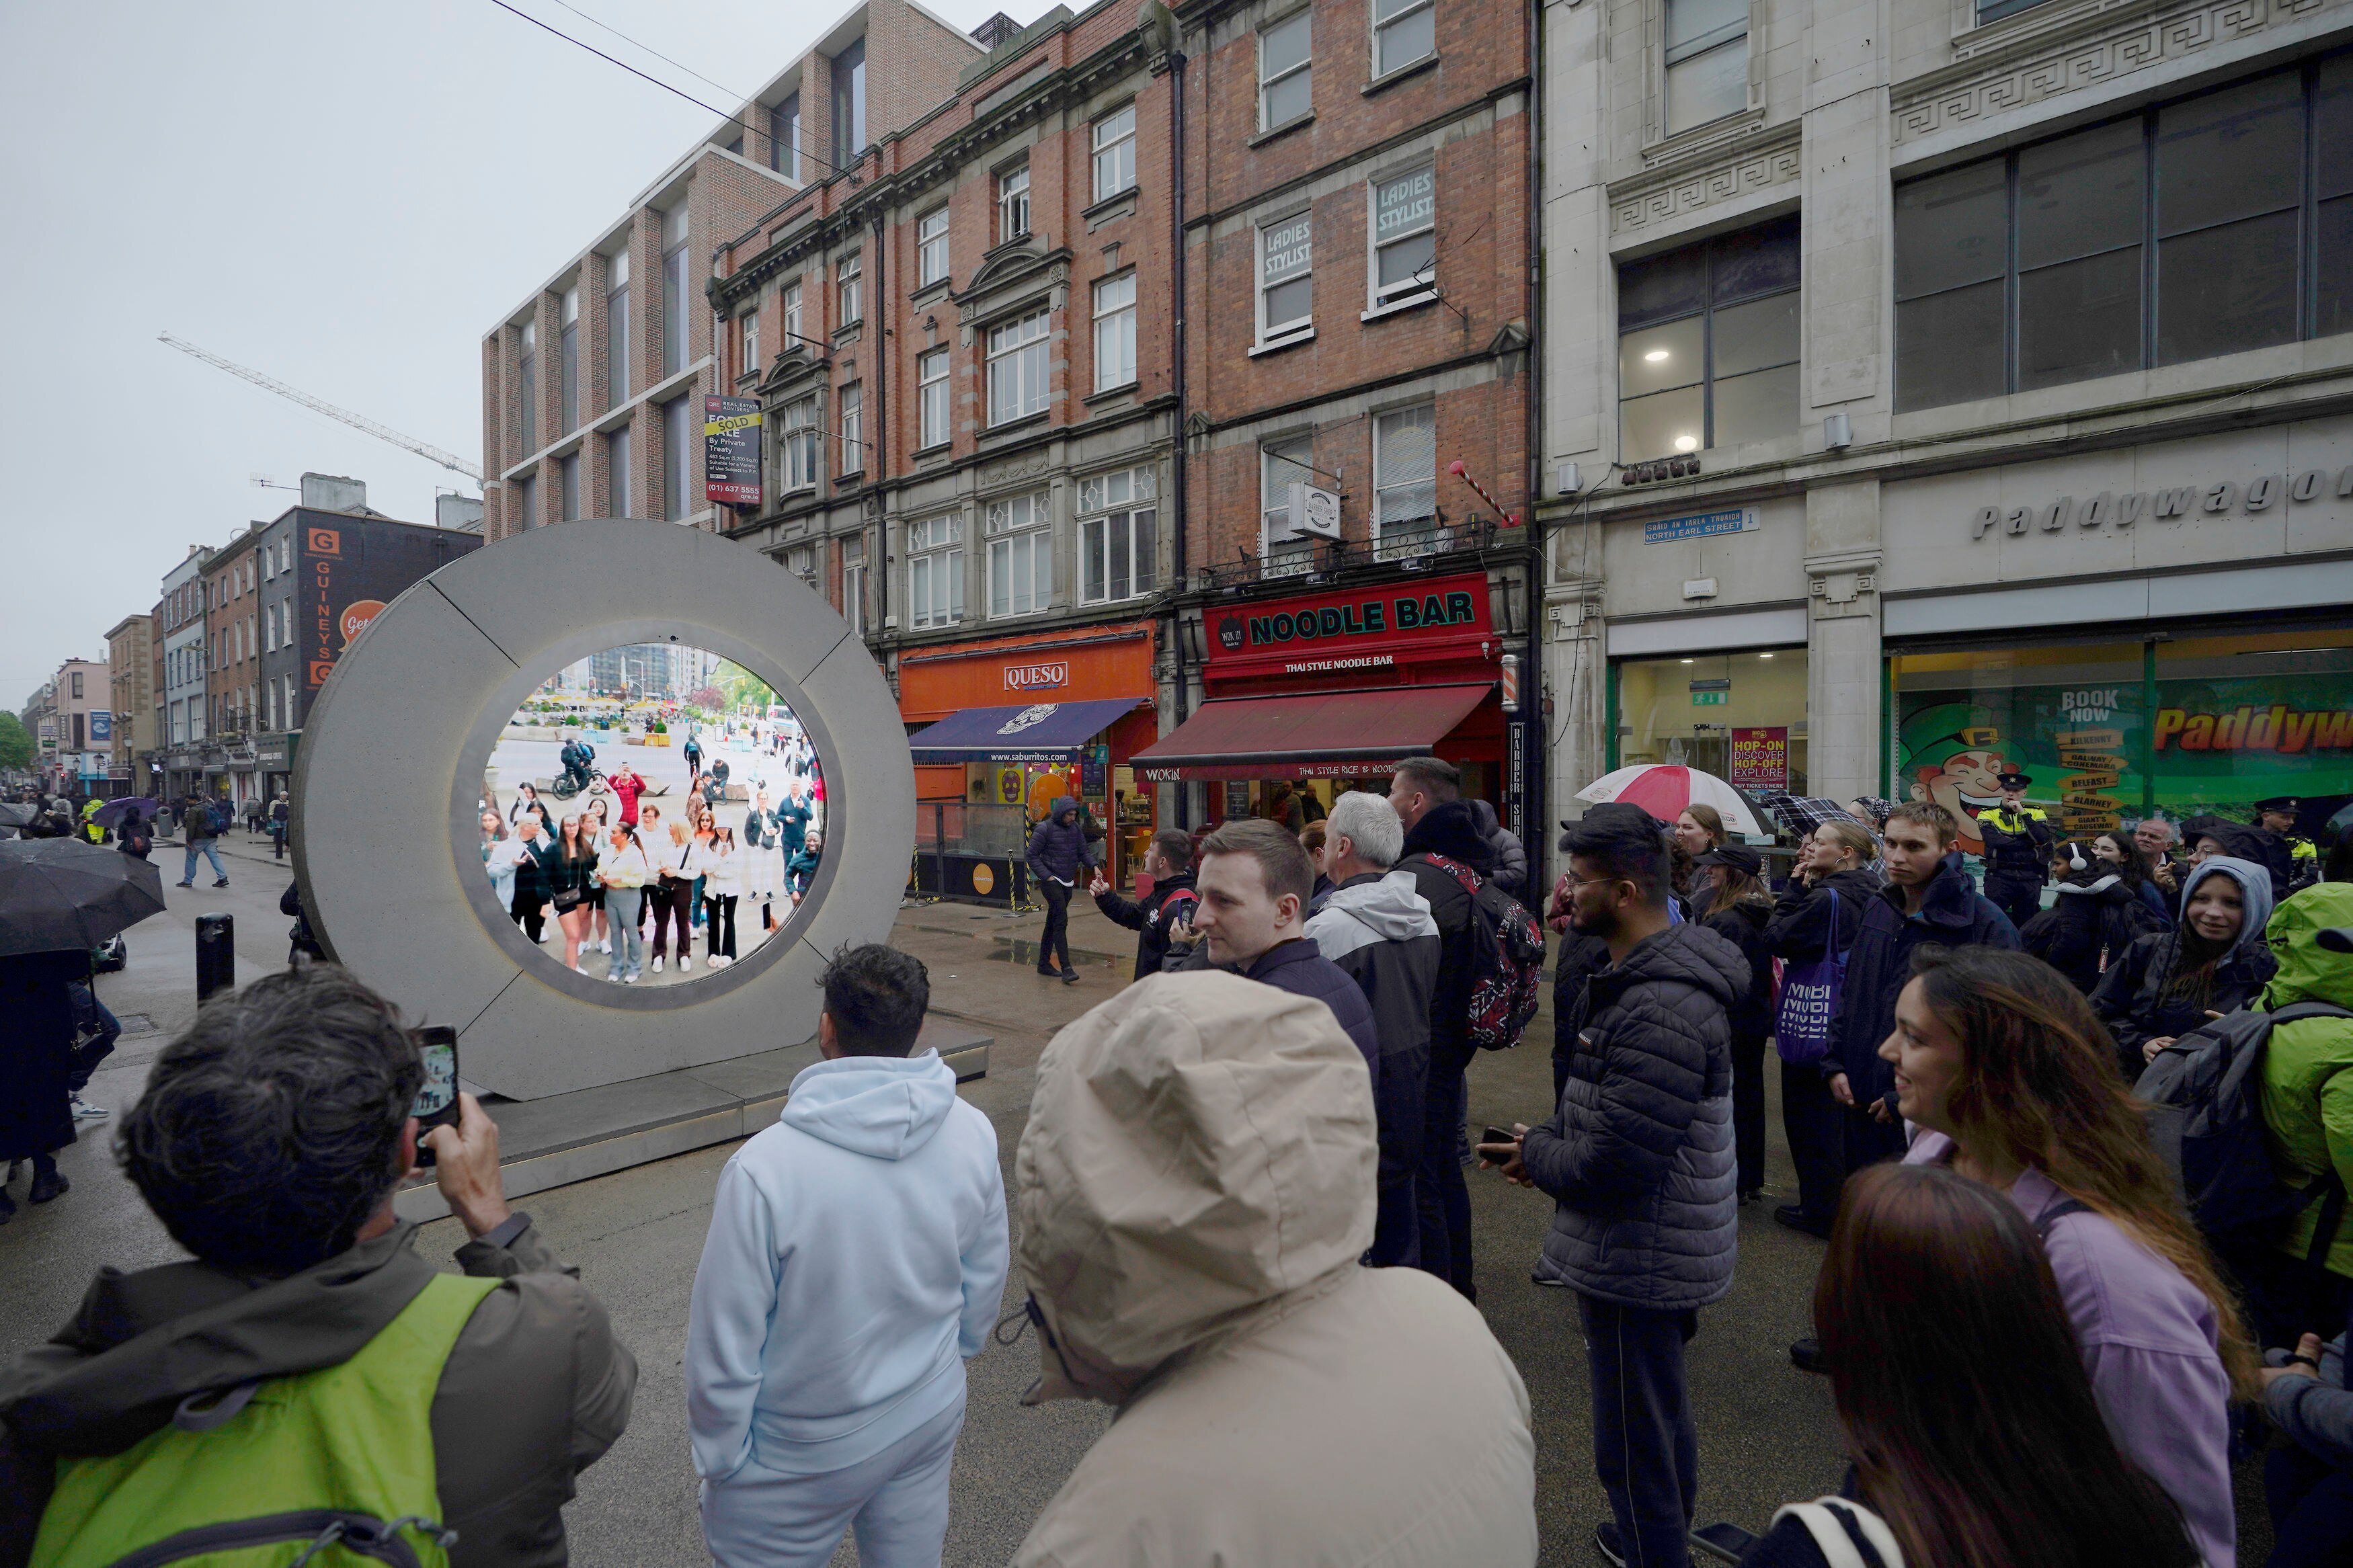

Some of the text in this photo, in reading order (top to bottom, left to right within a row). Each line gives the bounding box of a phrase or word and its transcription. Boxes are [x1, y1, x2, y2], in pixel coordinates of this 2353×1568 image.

[1382, 173, 1431, 208] LADIES
[1380, 196, 1433, 231] STYLIST
[1267, 221, 1310, 253] LADIES
[1266, 243, 1311, 275] STYLIST
[718, 418, 748, 431] SOLD
[709, 445, 732, 454] Treaty
[721, 439, 746, 447] Private
[1647, 522, 1668, 531] SRÁID
[1686, 517, 1705, 526] IARLA
[1710, 513, 1740, 522] THUAIDH
[1748, 513, 1753, 523] 1
[1646, 522, 1741, 541] NORTH EARL STREET
[314, 533, 333, 549] G
[316, 562, 331, 659] GUINEYS
[347, 616, 370, 634] Get
[1248, 591, 1475, 646] NOODLE BAR
[1222, 631, 1234, 641] WOK
[1285, 655, 1393, 672] THAI STYLE NOODLE BAR
[1008, 666, 1063, 690] QUESO
[2062, 690, 2119, 711] BOOK
[2071, 708, 2110, 722] NOW
[1735, 741, 1784, 751] HOP-ON
[2071, 735, 2111, 745] KILKENNY
[991, 752, 1067, 761] www.saburritos.com
[1735, 751, 1784, 759] DISCOVER
[1341, 766, 1358, 774] RICE
[1372, 765, 1397, 773] NOOD
[1735, 759, 1784, 768] HOP-OFF
[1146, 768, 1180, 781] WOKIN
[1735, 768, 1784, 777] EXPLORE
[2072, 777, 2107, 787] BELFAST
[2074, 796, 2111, 808] BLARNEY
[1788, 983, 1831, 1000] MUBI
